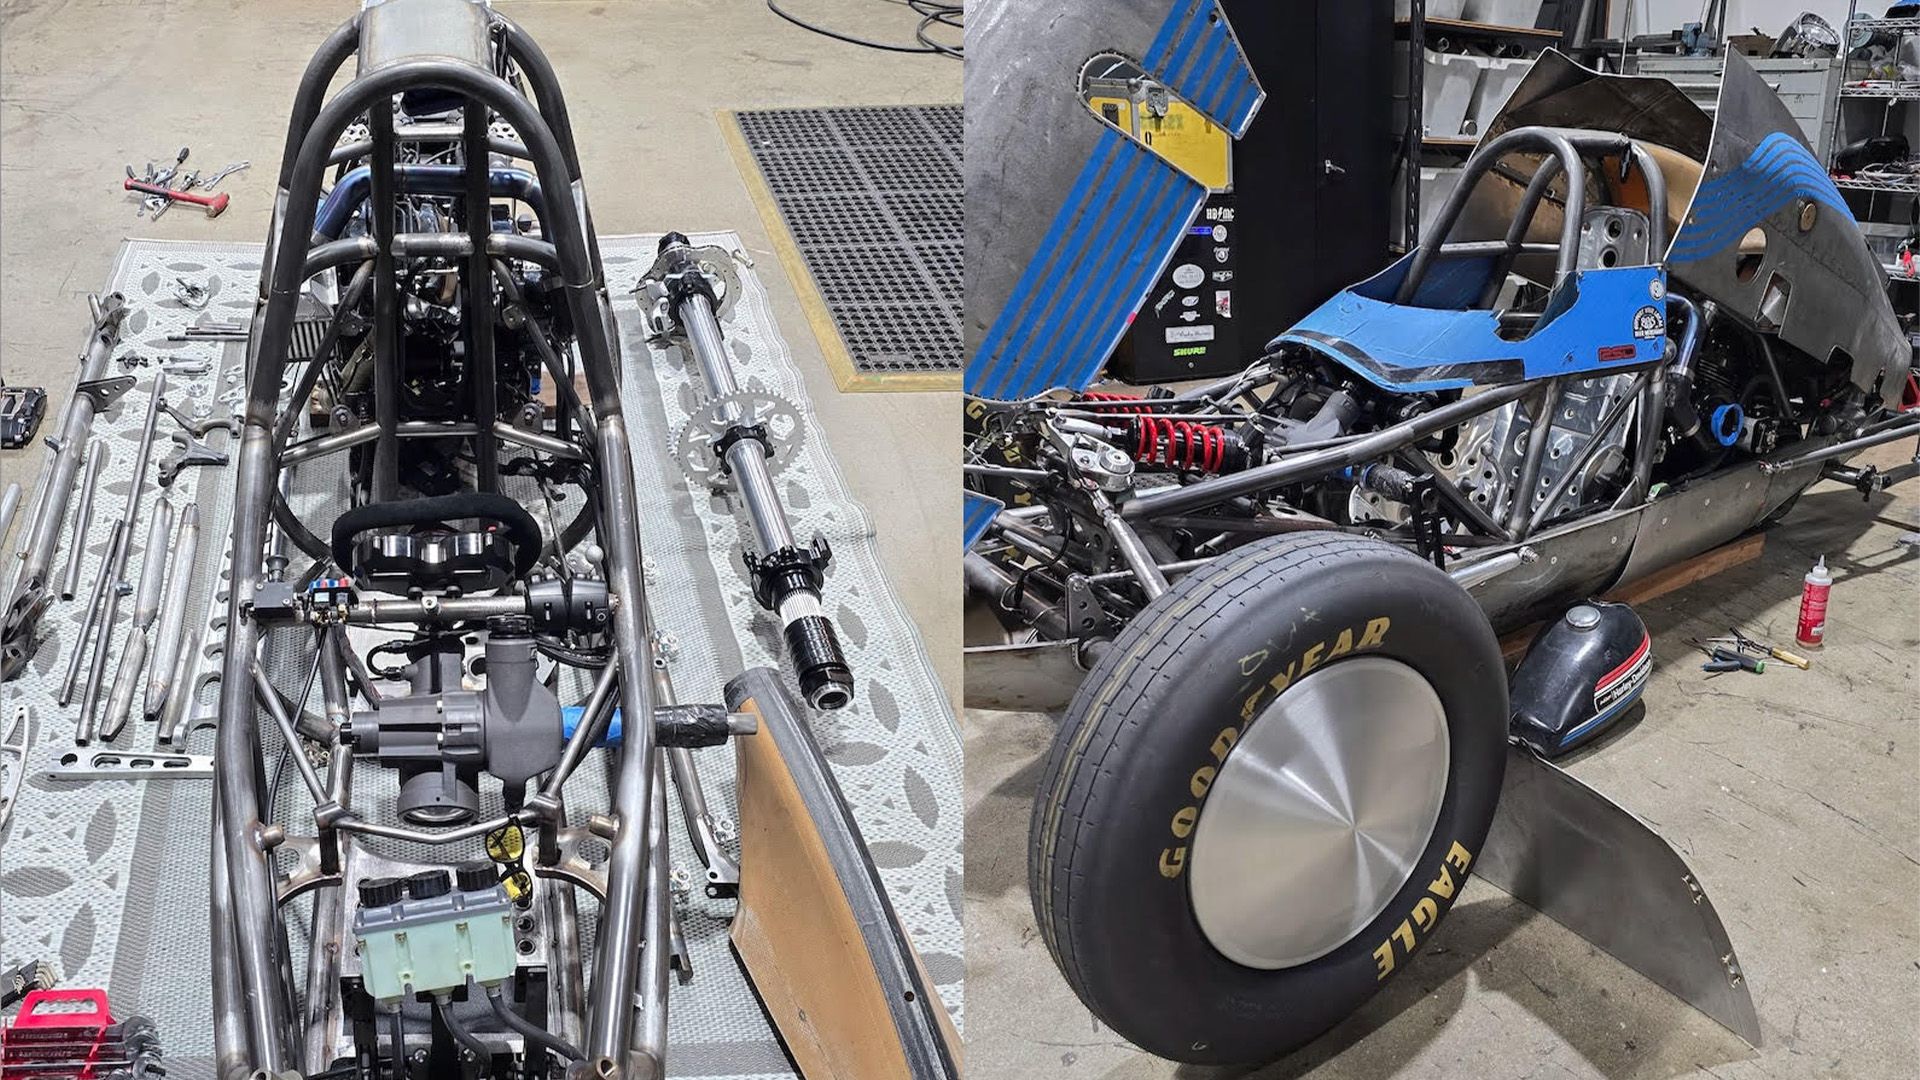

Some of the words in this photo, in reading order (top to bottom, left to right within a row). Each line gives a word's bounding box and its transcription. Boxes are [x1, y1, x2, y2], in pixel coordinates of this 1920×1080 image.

[1173, 346, 1207, 357] SHURE
[1158, 615, 1391, 879] GOODYEAR
[1372, 839, 1473, 982] EAGLE
